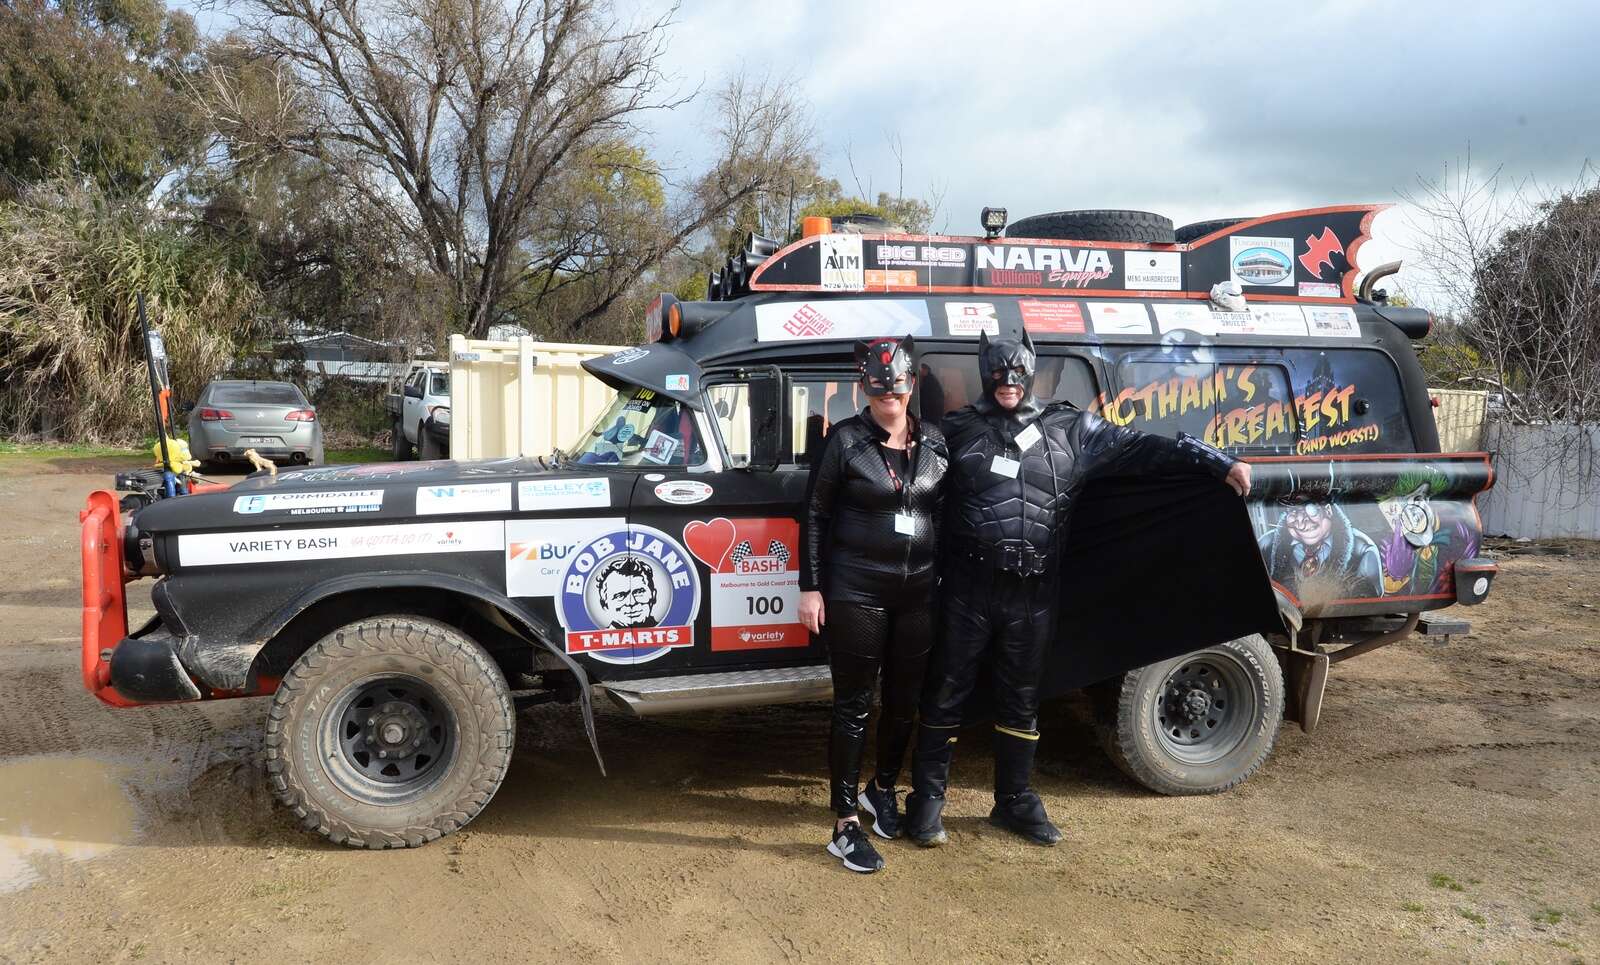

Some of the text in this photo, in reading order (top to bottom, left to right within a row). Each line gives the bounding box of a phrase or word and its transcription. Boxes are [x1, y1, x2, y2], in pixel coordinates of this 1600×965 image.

[825, 255, 859, 269] AIM
[877, 246, 966, 262] BIG RED
[977, 245, 1111, 272] NARVA
[783, 303, 817, 335] FLEET
[1203, 384, 1355, 450] GREATEST
[1330, 424, 1379, 448] WORST!)
[272, 490, 379, 501] FORMIDABLE
[290, 506, 336, 515] MELBOURNE
[229, 537, 338, 553] VARIETY BASH
[566, 530, 691, 595] BOB JANE
[741, 560, 780, 573] BASH
[746, 596, 784, 615] 100
[580, 629, 679, 648] T-MARTS
[751, 631, 785, 642] variety
